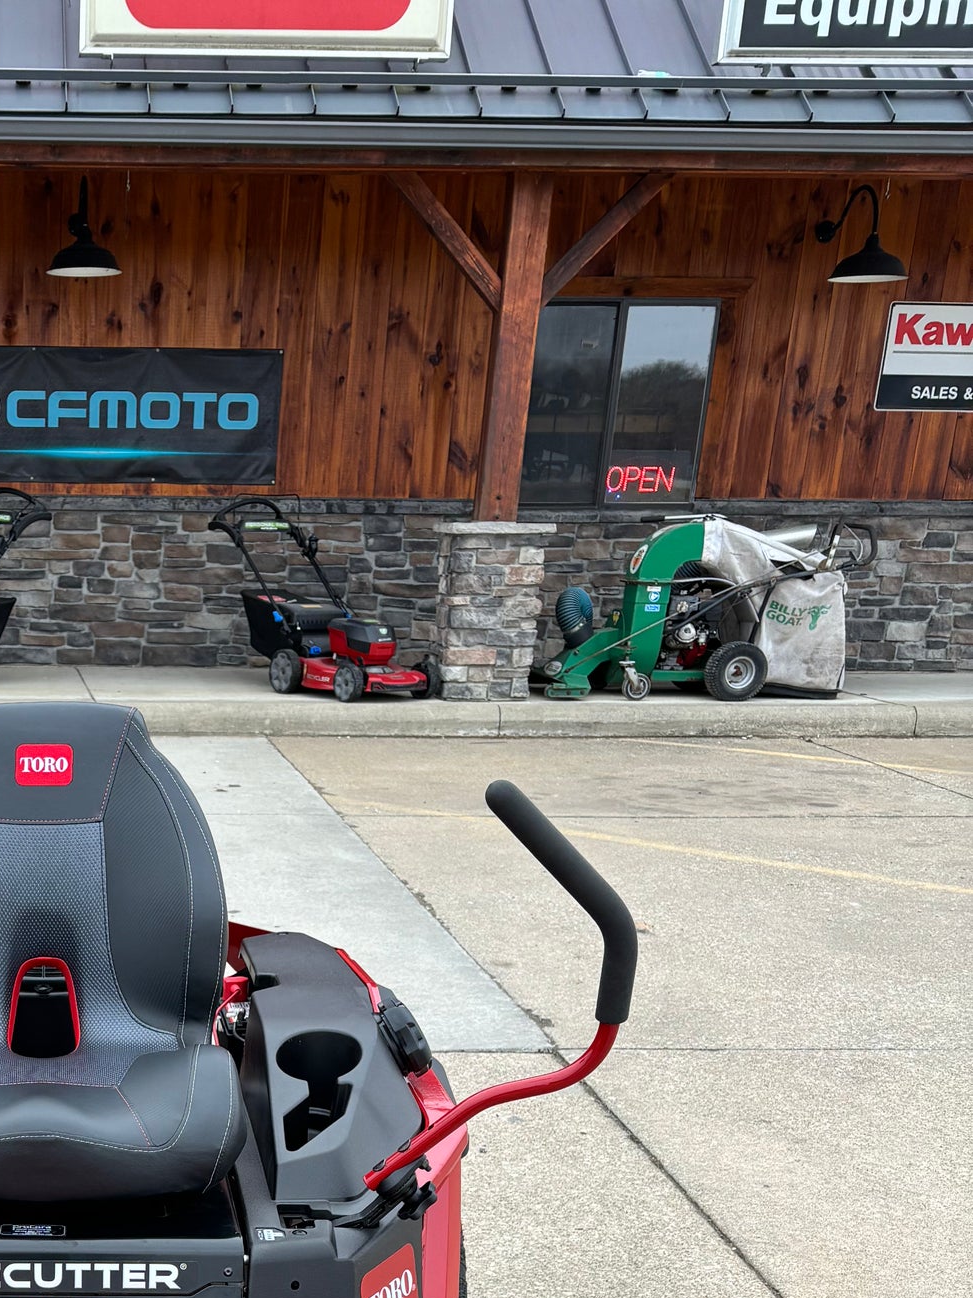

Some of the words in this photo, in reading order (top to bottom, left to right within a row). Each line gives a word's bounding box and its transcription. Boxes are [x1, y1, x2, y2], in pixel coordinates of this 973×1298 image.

[911, 386, 958, 400] SALES
[6, 390, 259, 430] CFMOTO
[605, 465, 675, 493] OPEN
[769, 600, 806, 616] BILLY
[19, 756, 68, 773] TORO
